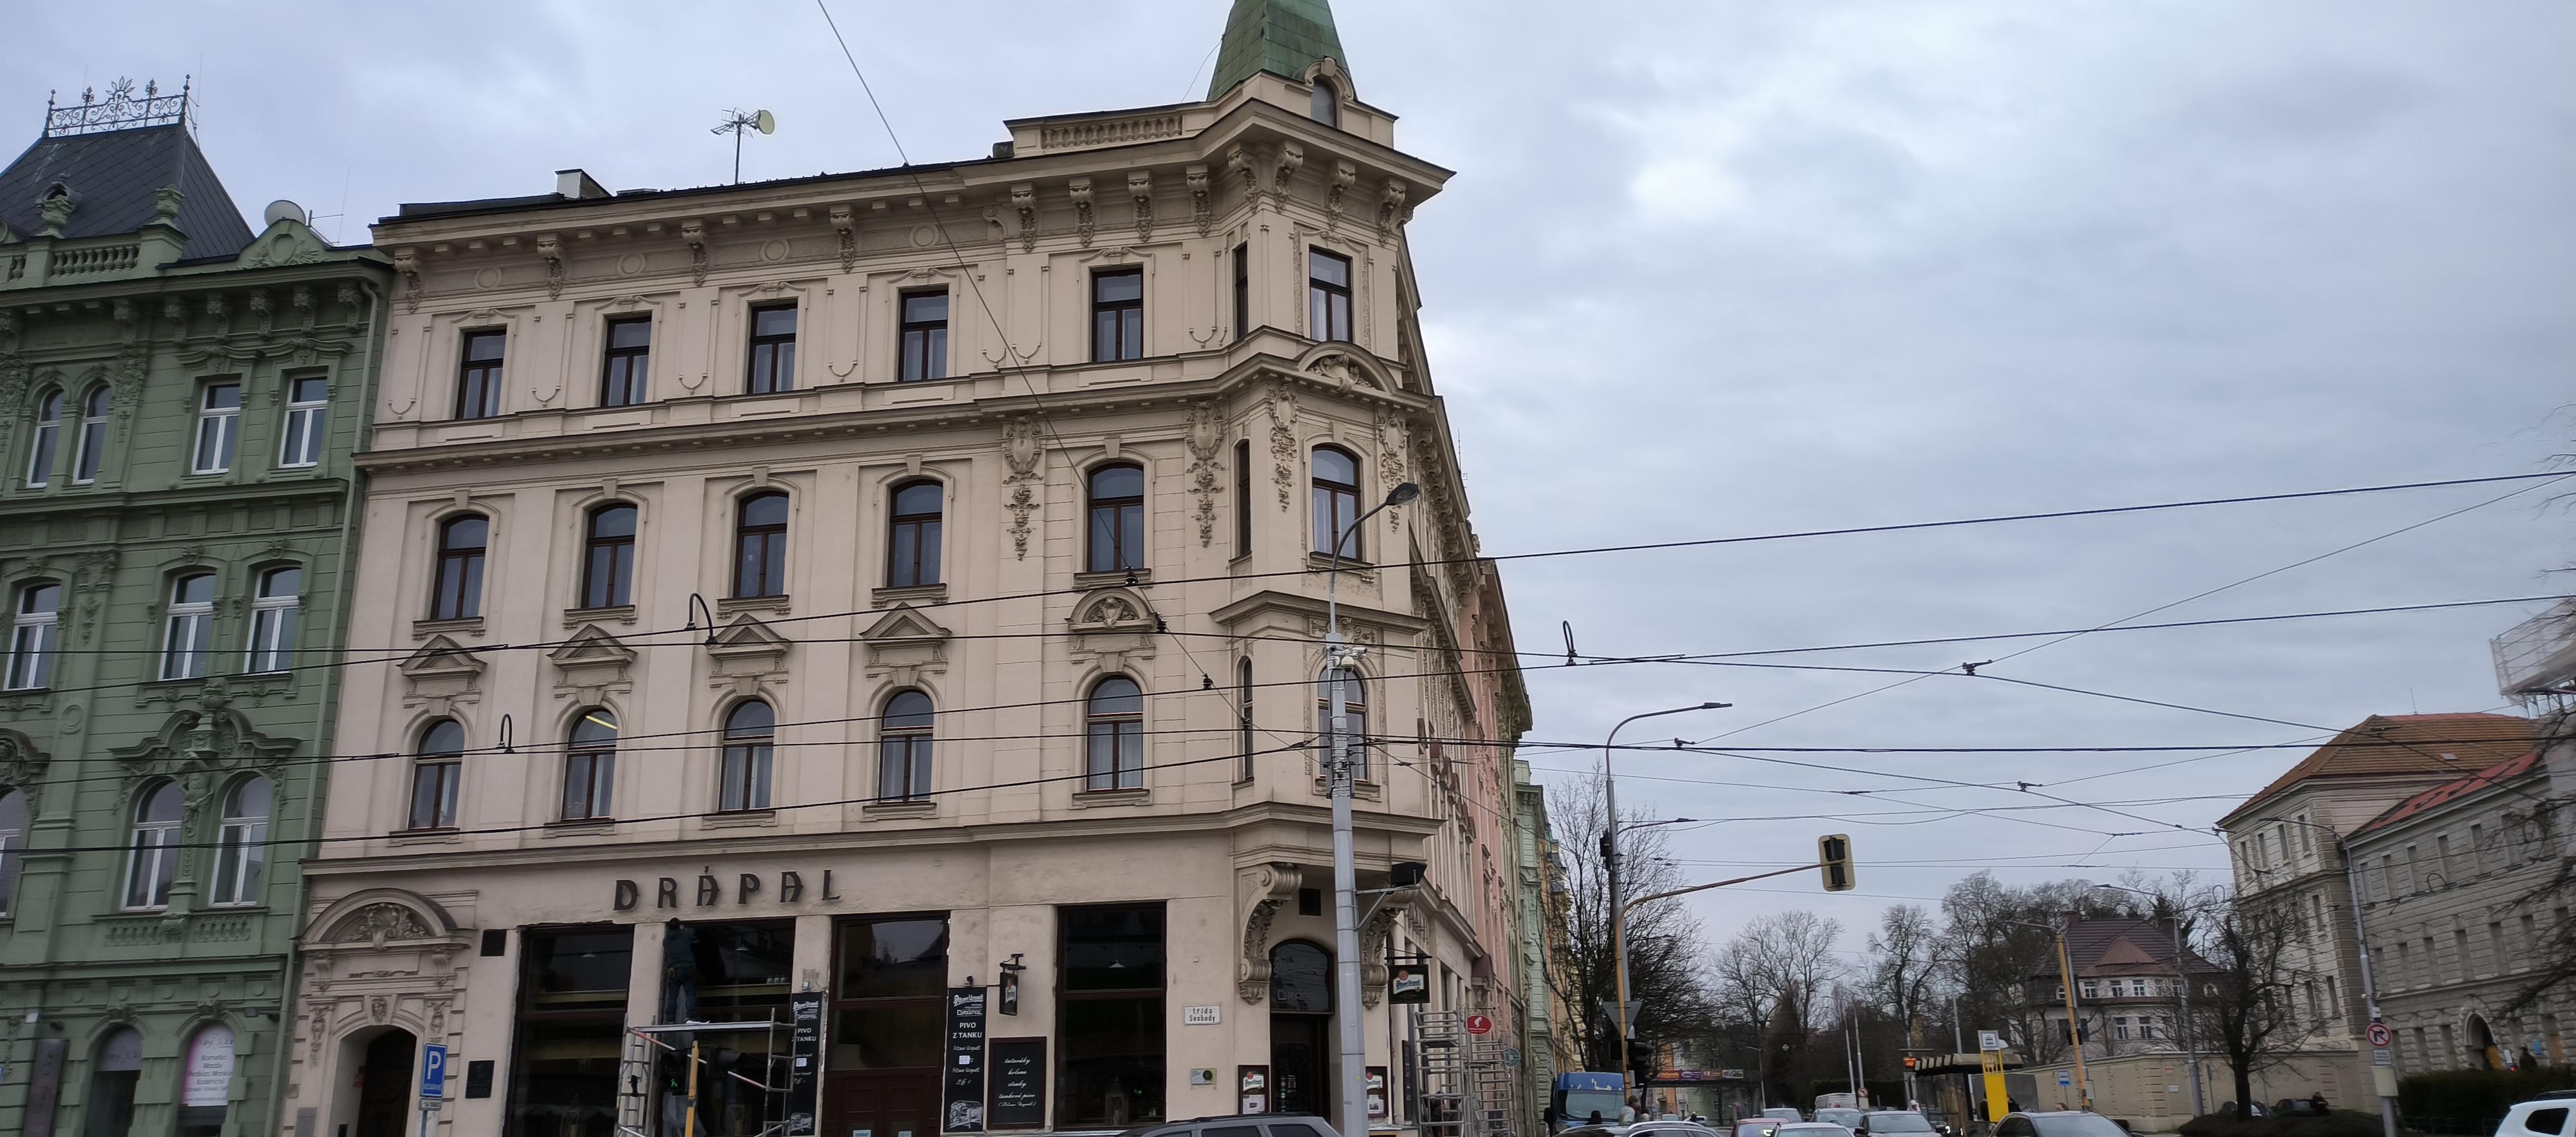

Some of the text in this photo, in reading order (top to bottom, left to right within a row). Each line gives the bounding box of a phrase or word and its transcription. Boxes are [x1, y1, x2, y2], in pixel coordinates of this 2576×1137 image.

[613, 865, 841, 911] DRÁPAL
[1189, 1014, 1216, 1023] Svobody
[427, 1051, 442, 1080] P
